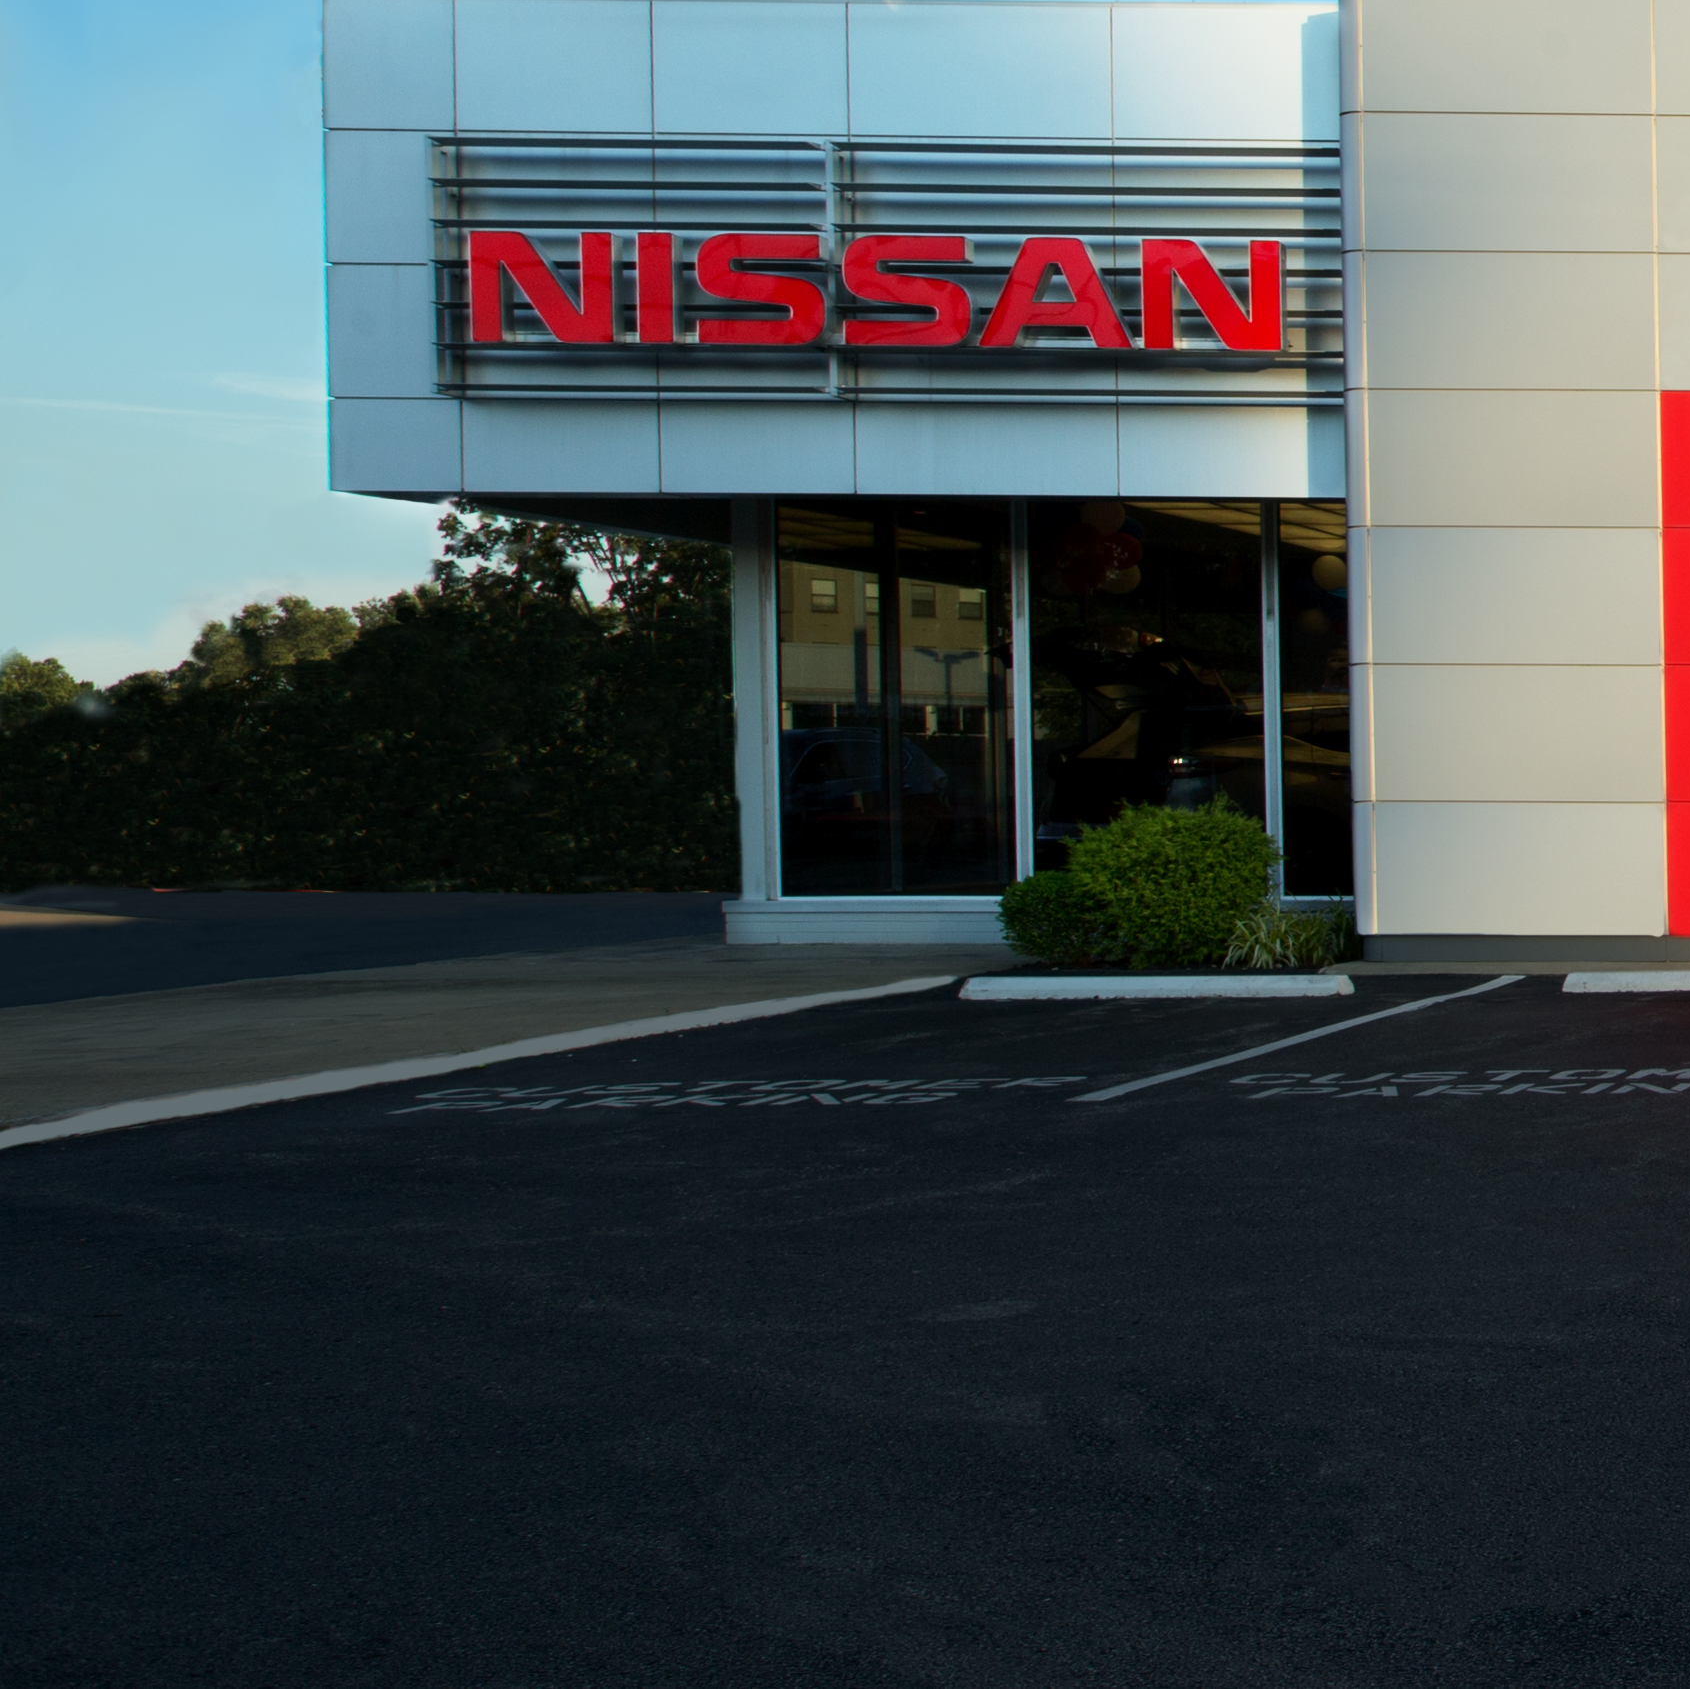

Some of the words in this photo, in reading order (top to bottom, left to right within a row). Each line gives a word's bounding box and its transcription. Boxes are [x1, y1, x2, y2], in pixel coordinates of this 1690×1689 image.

[467, 230, 1285, 352] NISSAN
[415, 1076, 1088, 1099] CUSTOMER
[389, 1092, 958, 1114] PARKING
